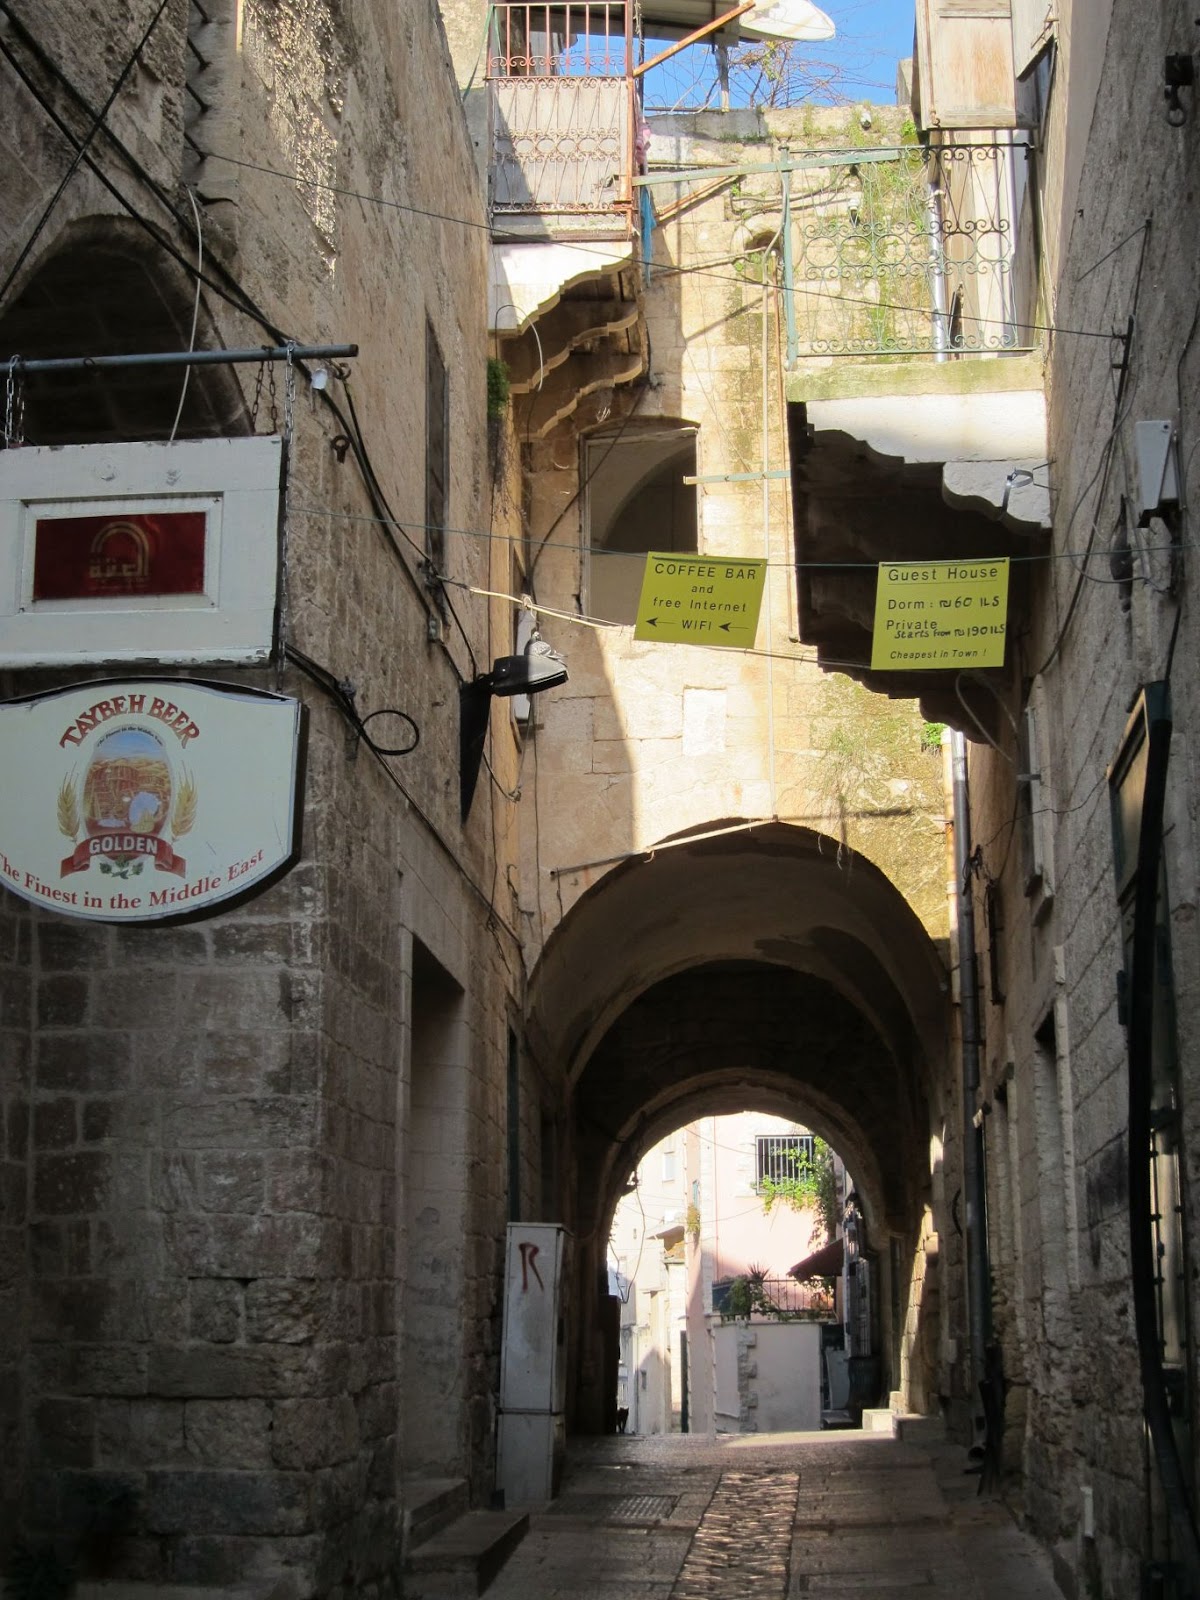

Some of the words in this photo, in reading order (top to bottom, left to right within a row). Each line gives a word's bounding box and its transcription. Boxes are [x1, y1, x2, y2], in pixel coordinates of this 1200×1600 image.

[654, 563, 716, 578] COFFEE
[725, 568, 756, 579] BAR
[888, 568, 937, 581] Guest
[947, 567, 998, 579] House
[691, 585, 714, 594] and
[653, 597, 681, 608] free
[690, 599, 746, 612] Internet
[886, 619, 938, 630] Private
[890, 649, 937, 660] Cheapest
[940, 649, 948, 658] in
[59, 694, 147, 749] TAYBEH
[146, 696, 200, 749] BEER
[89, 836, 158, 855] GOLDEN
[24, 871, 78, 906] Finest
[83, 891, 103, 908] in
[109, 893, 142, 910] the
[149, 876, 222, 907] Middle
[227, 849, 265, 883] East
